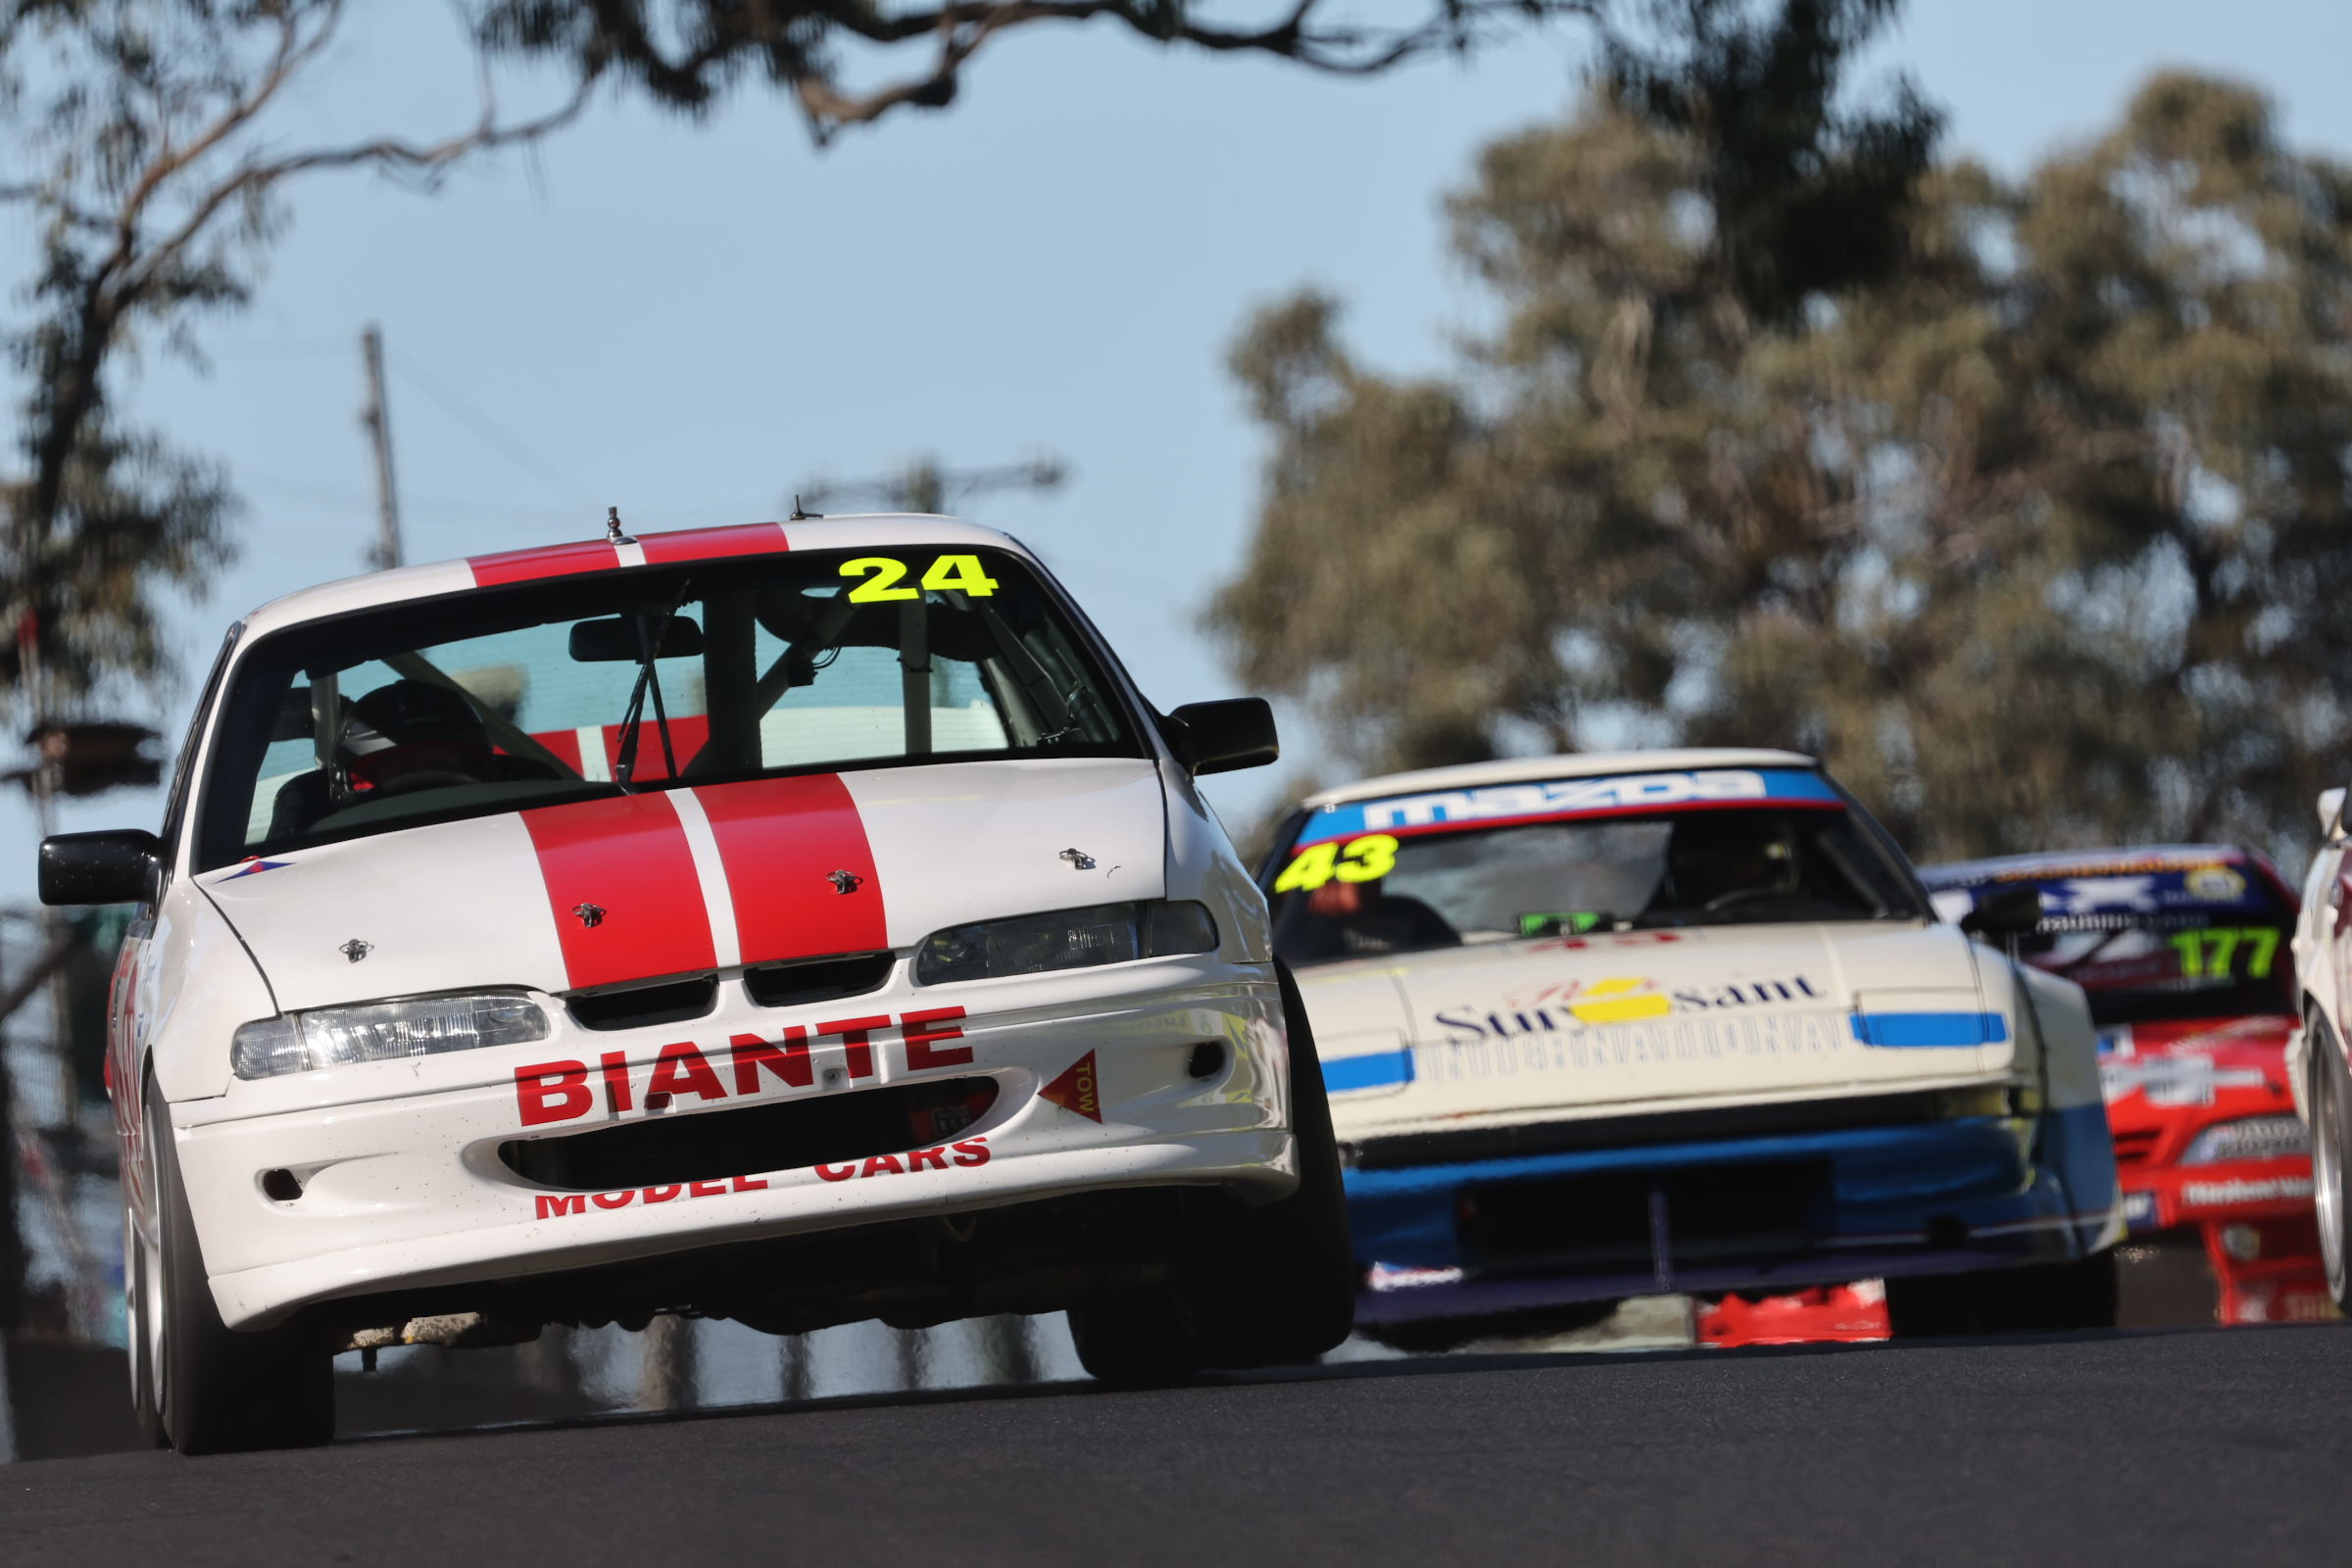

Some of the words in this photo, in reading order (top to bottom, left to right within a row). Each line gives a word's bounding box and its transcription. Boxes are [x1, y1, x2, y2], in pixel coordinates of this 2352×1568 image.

[839, 555, 1000, 604] 24
[1275, 834, 1398, 894] 43
[2168, 925, 2280, 978] 177
[514, 1005, 974, 1127] BIANTE
[1076, 1061, 1095, 1111] TOW
[535, 1175, 768, 1220] MODEL
[813, 1137, 991, 1182] CARS
